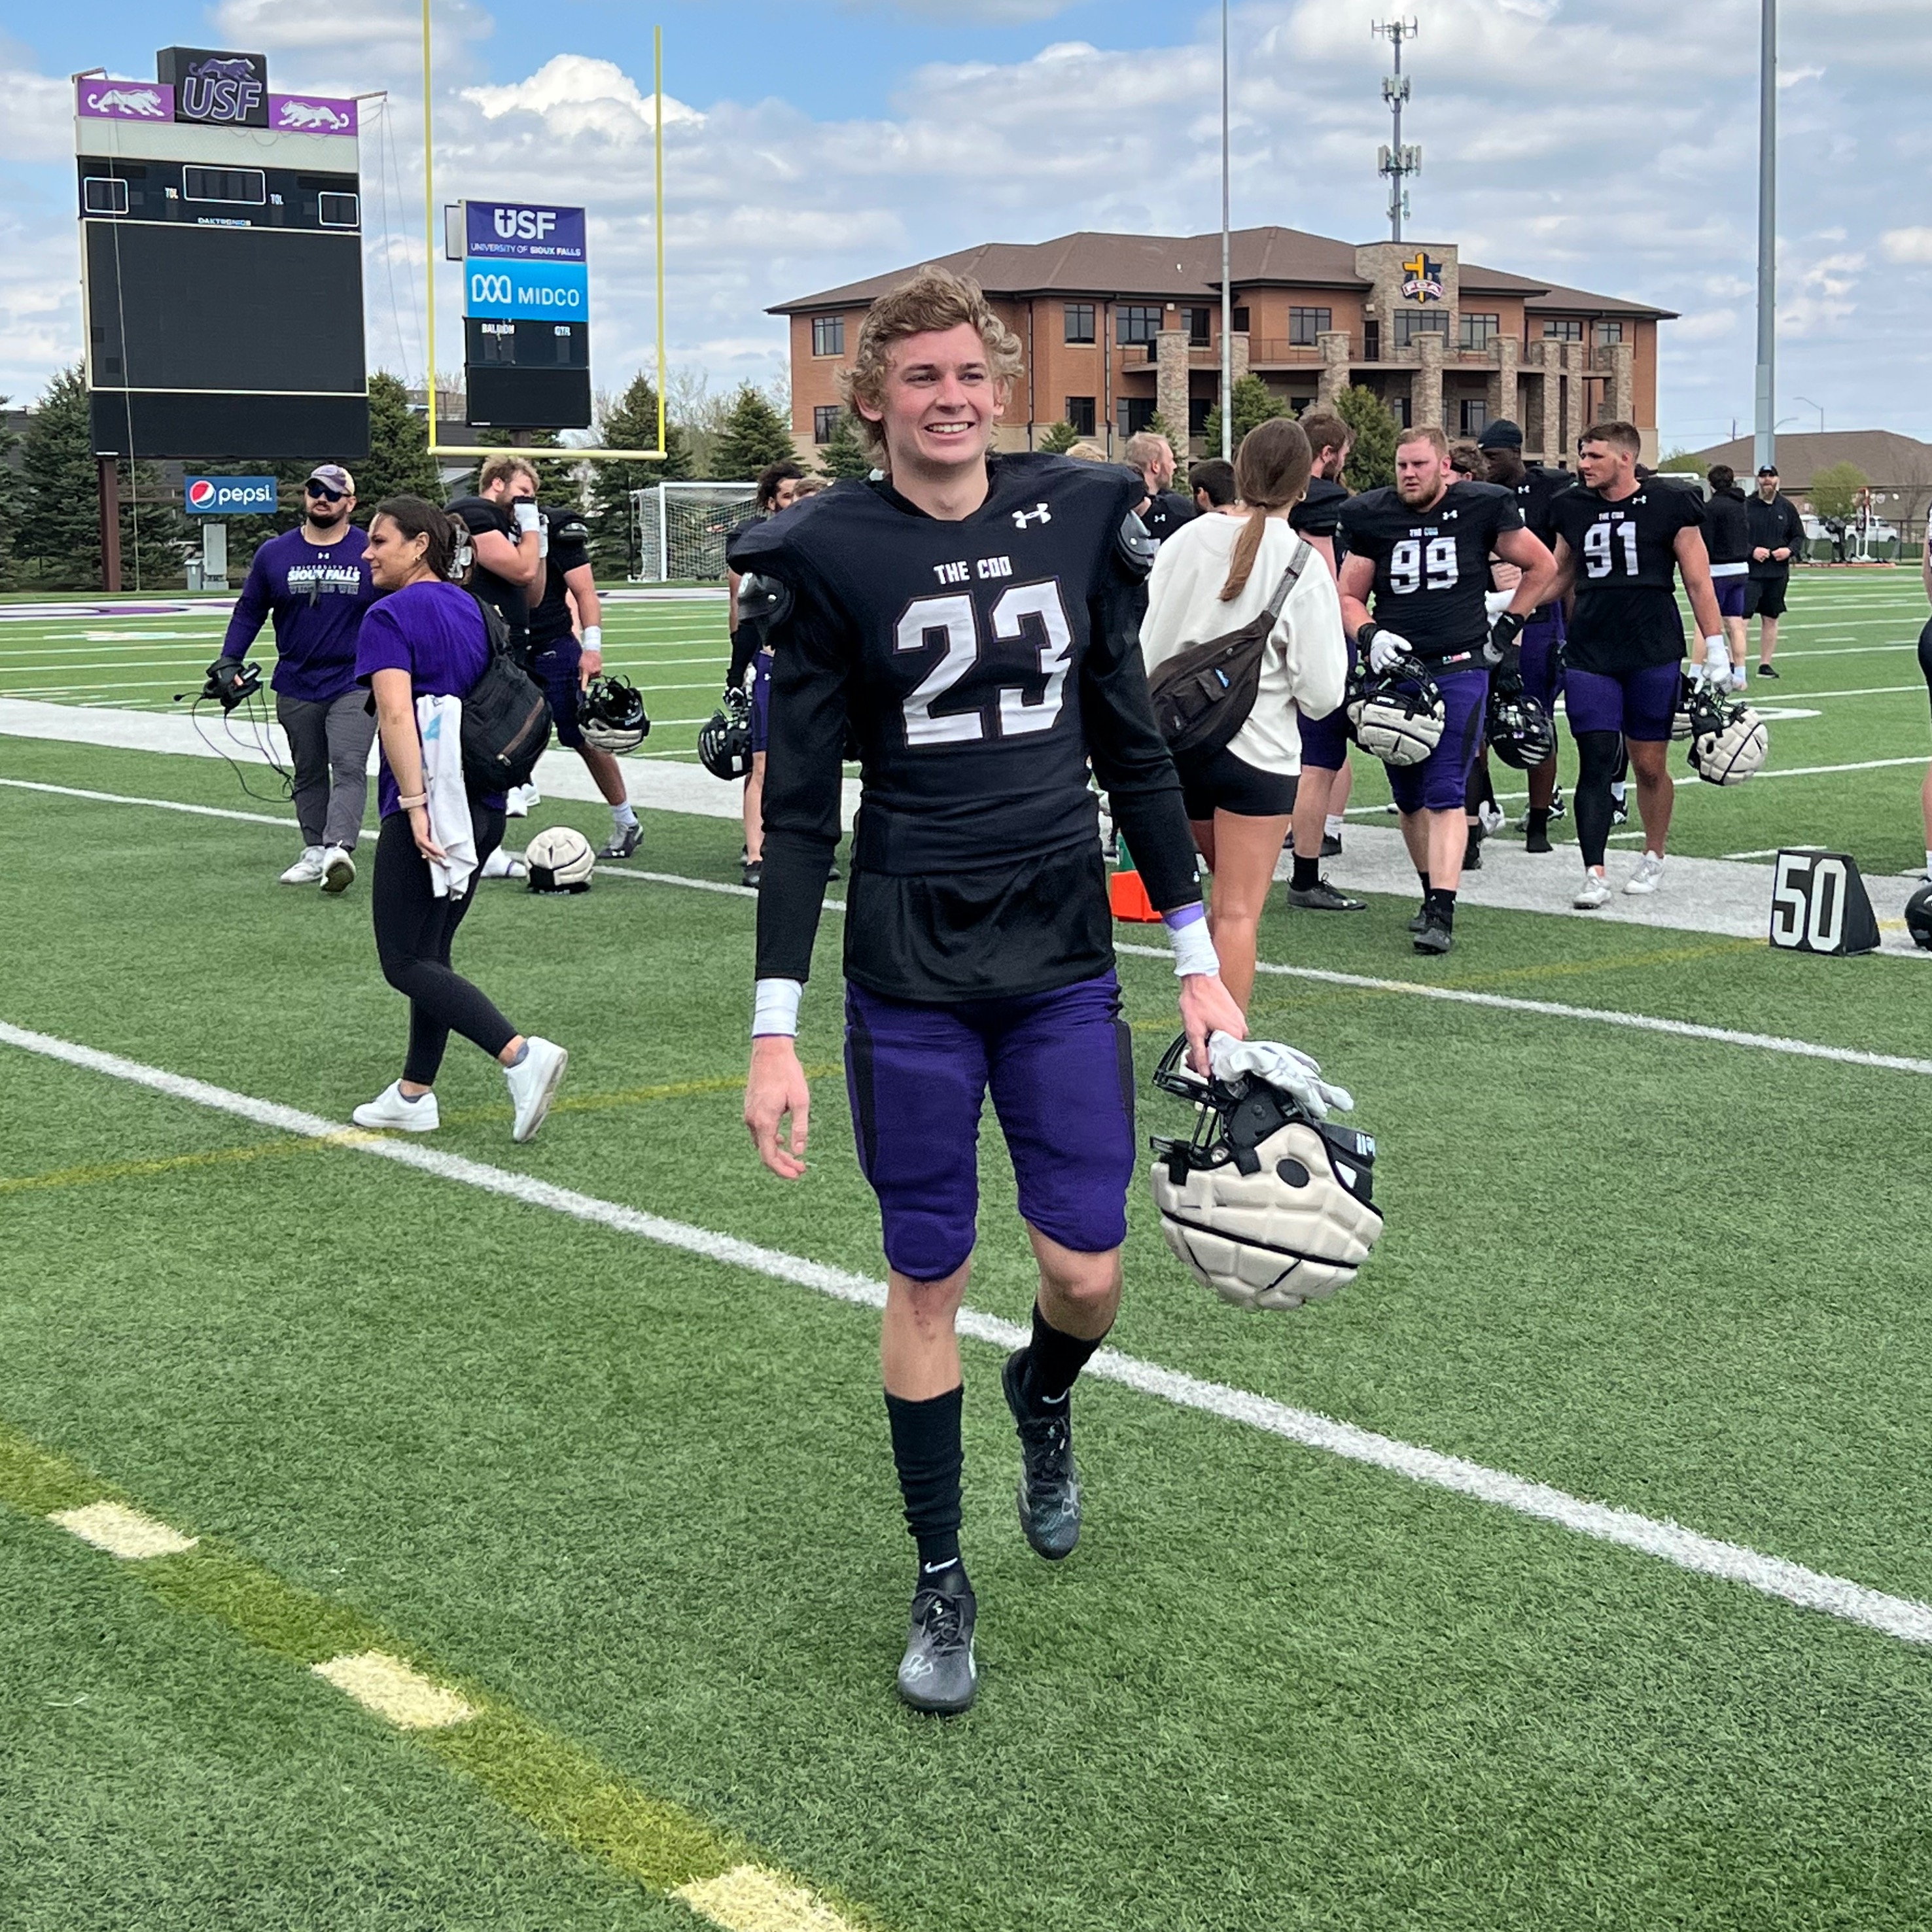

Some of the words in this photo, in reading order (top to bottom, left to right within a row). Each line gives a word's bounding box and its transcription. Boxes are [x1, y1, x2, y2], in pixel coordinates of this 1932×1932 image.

[183, 77, 262, 120] USF
[494, 209, 556, 239] USF
[470, 243, 516, 253] UNIVERSITY
[517, 245, 528, 254] OF
[530, 246, 555, 255] SIOUX
[556, 247, 581, 256] FALLS
[518, 287, 580, 307] MIDCO
[219, 484, 271, 505] pepsi
[1583, 521, 1639, 578] 91
[325, 569, 361, 582] FALLS
[933, 561, 970, 585] THE
[977, 556, 1013, 579] COO
[1390, 536, 1459, 594] 99
[894, 577, 1074, 748] 23
[1772, 854, 1847, 951] 50
